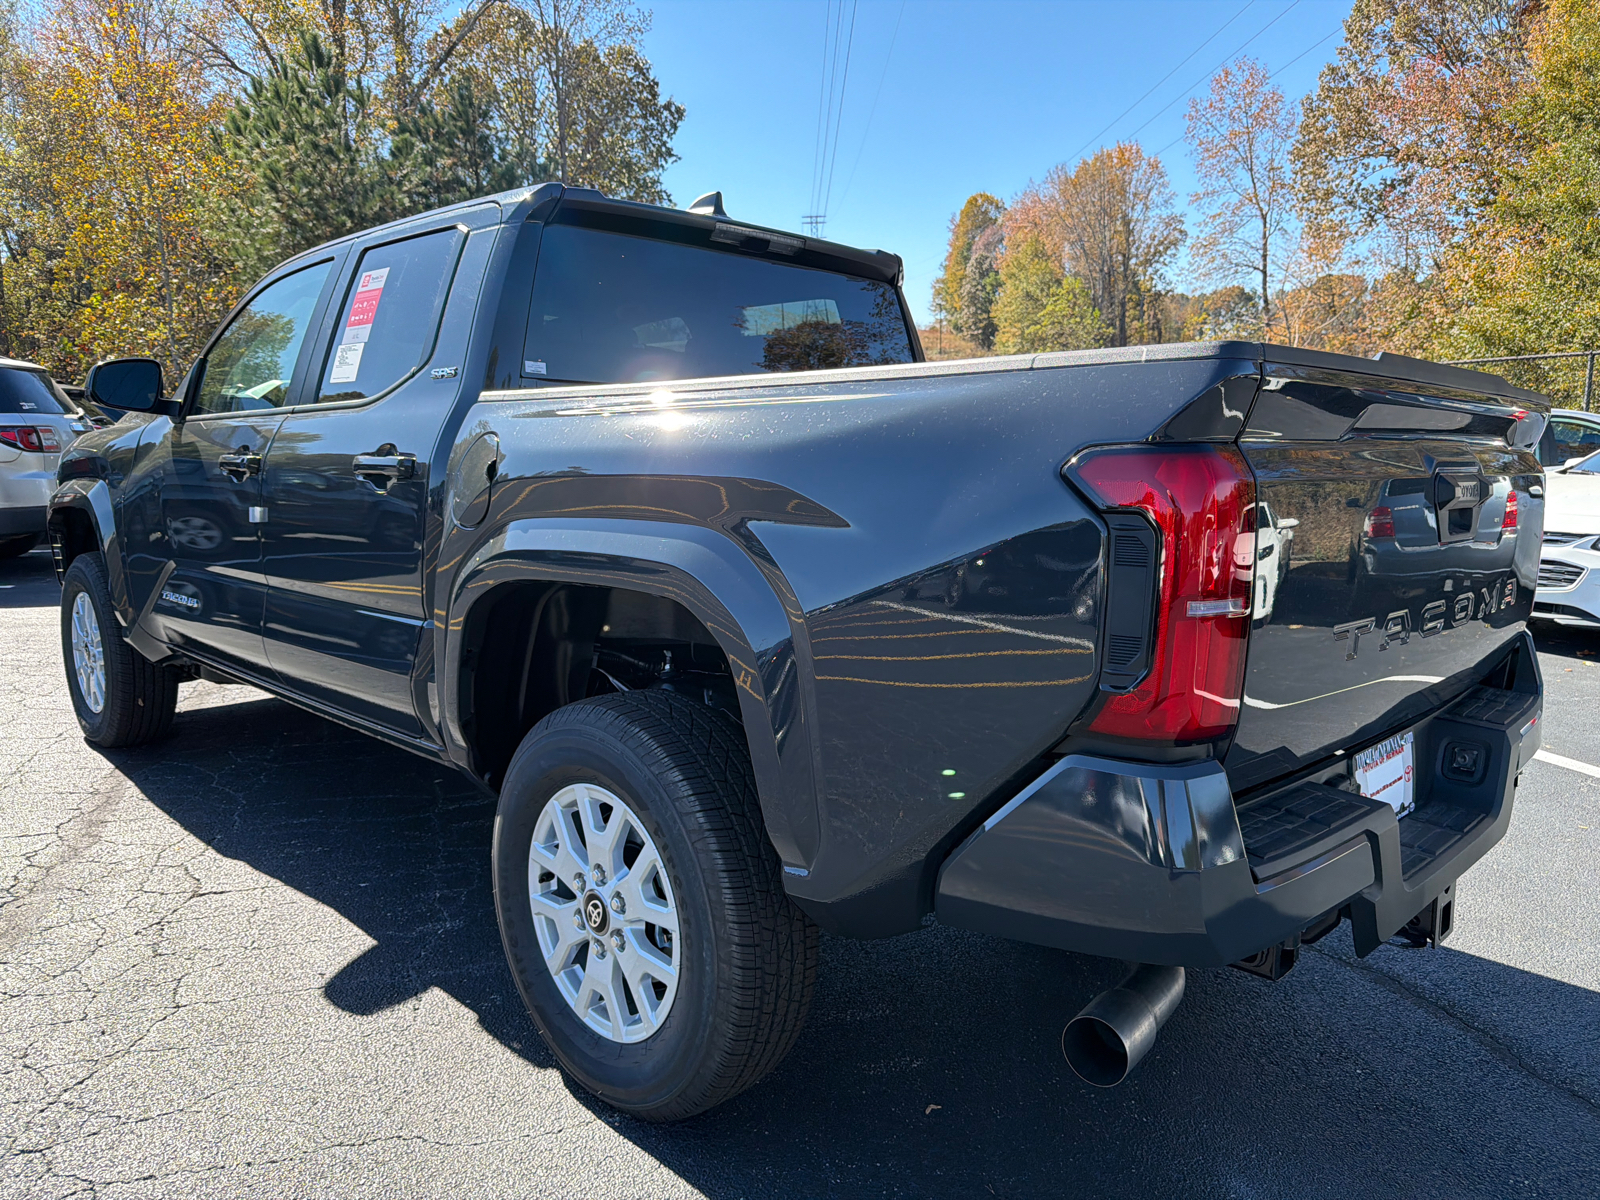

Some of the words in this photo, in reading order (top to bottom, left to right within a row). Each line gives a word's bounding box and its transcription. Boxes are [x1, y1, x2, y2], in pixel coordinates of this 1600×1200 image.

[430, 366, 458, 380] SR5
[161, 590, 201, 608] TACOMA
[1333, 577, 1517, 662] TACOMA
